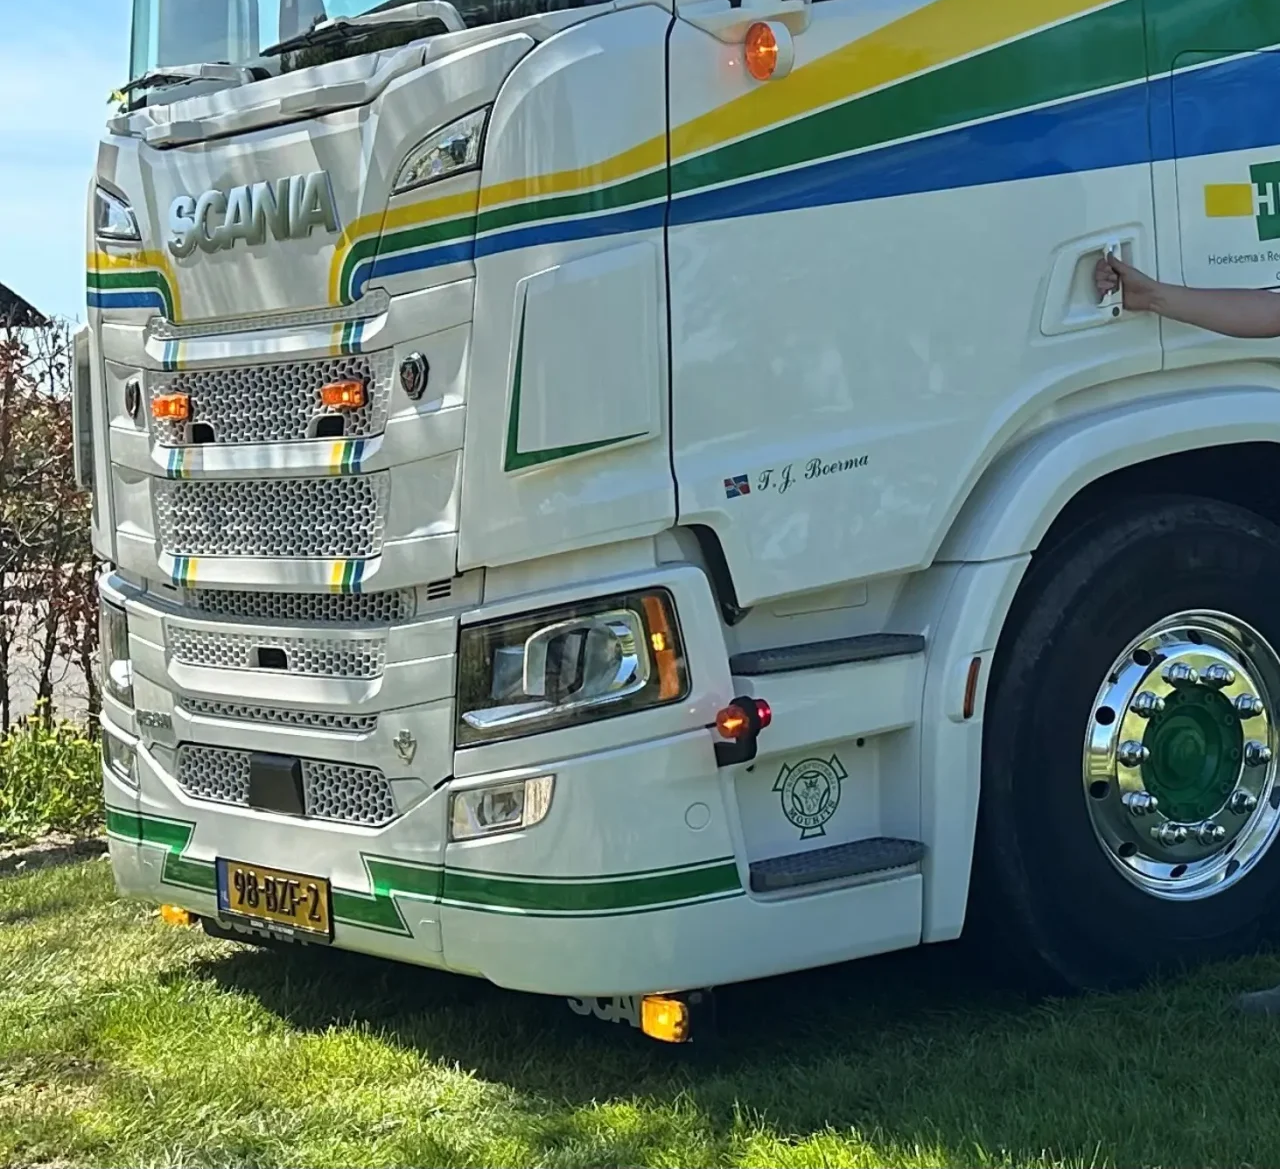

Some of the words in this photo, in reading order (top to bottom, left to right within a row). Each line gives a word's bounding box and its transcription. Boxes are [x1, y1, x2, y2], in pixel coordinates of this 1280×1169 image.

[168, 170, 342, 259] SCANIA
[1208, 251, 1266, 265] Hoeksema's
[804, 454, 869, 480] Boerma
[233, 868, 321, 922] 98-BZF-2
